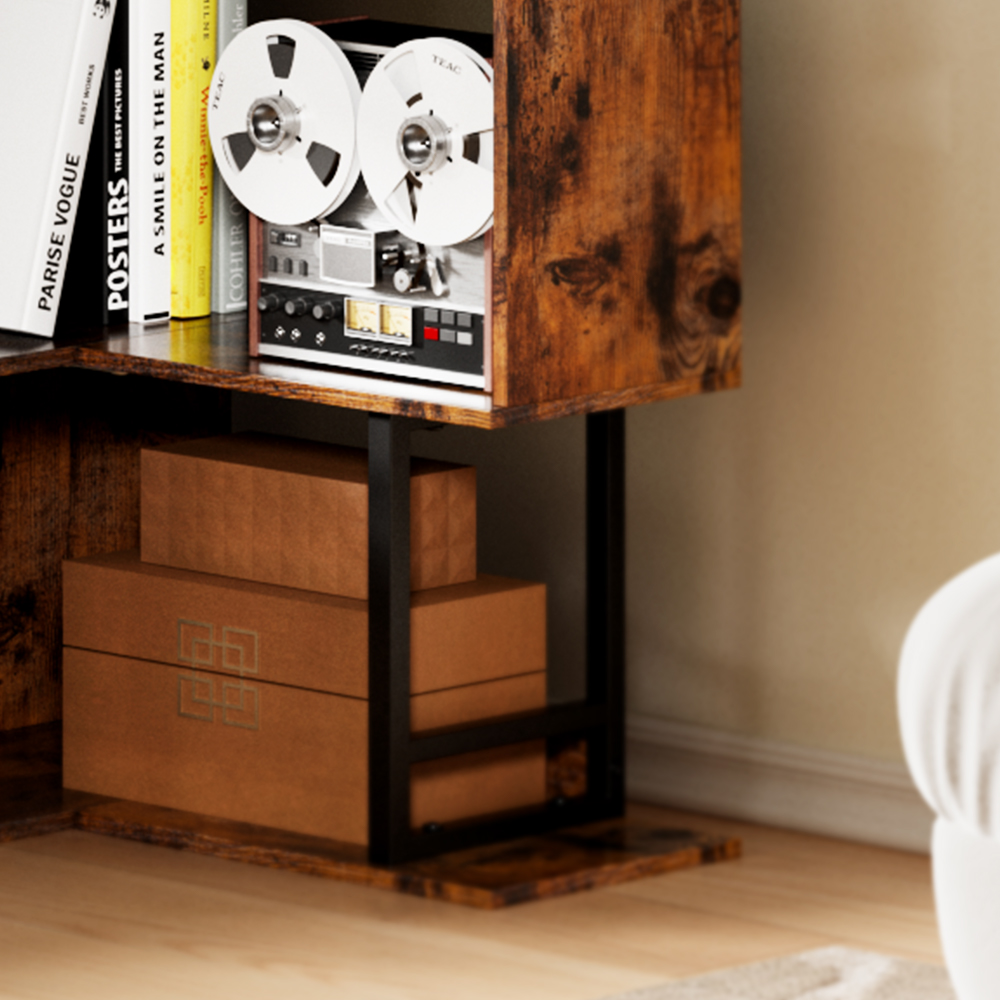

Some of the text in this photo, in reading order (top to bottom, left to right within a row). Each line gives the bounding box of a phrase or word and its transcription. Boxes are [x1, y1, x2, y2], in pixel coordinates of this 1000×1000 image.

[212, 71, 226, 110] TEAC
[432, 53, 462, 75] TEAC
[107, 67, 129, 311] POSTERS THE BEST PICTURES
[153, 31, 165, 256] A SMILE ON THE MAN
[198, 86, 210, 226] Winnie-the-Pooh
[37, 152, 81, 312] PARISE VOGUE
[229, 222, 244, 302] COHLER
